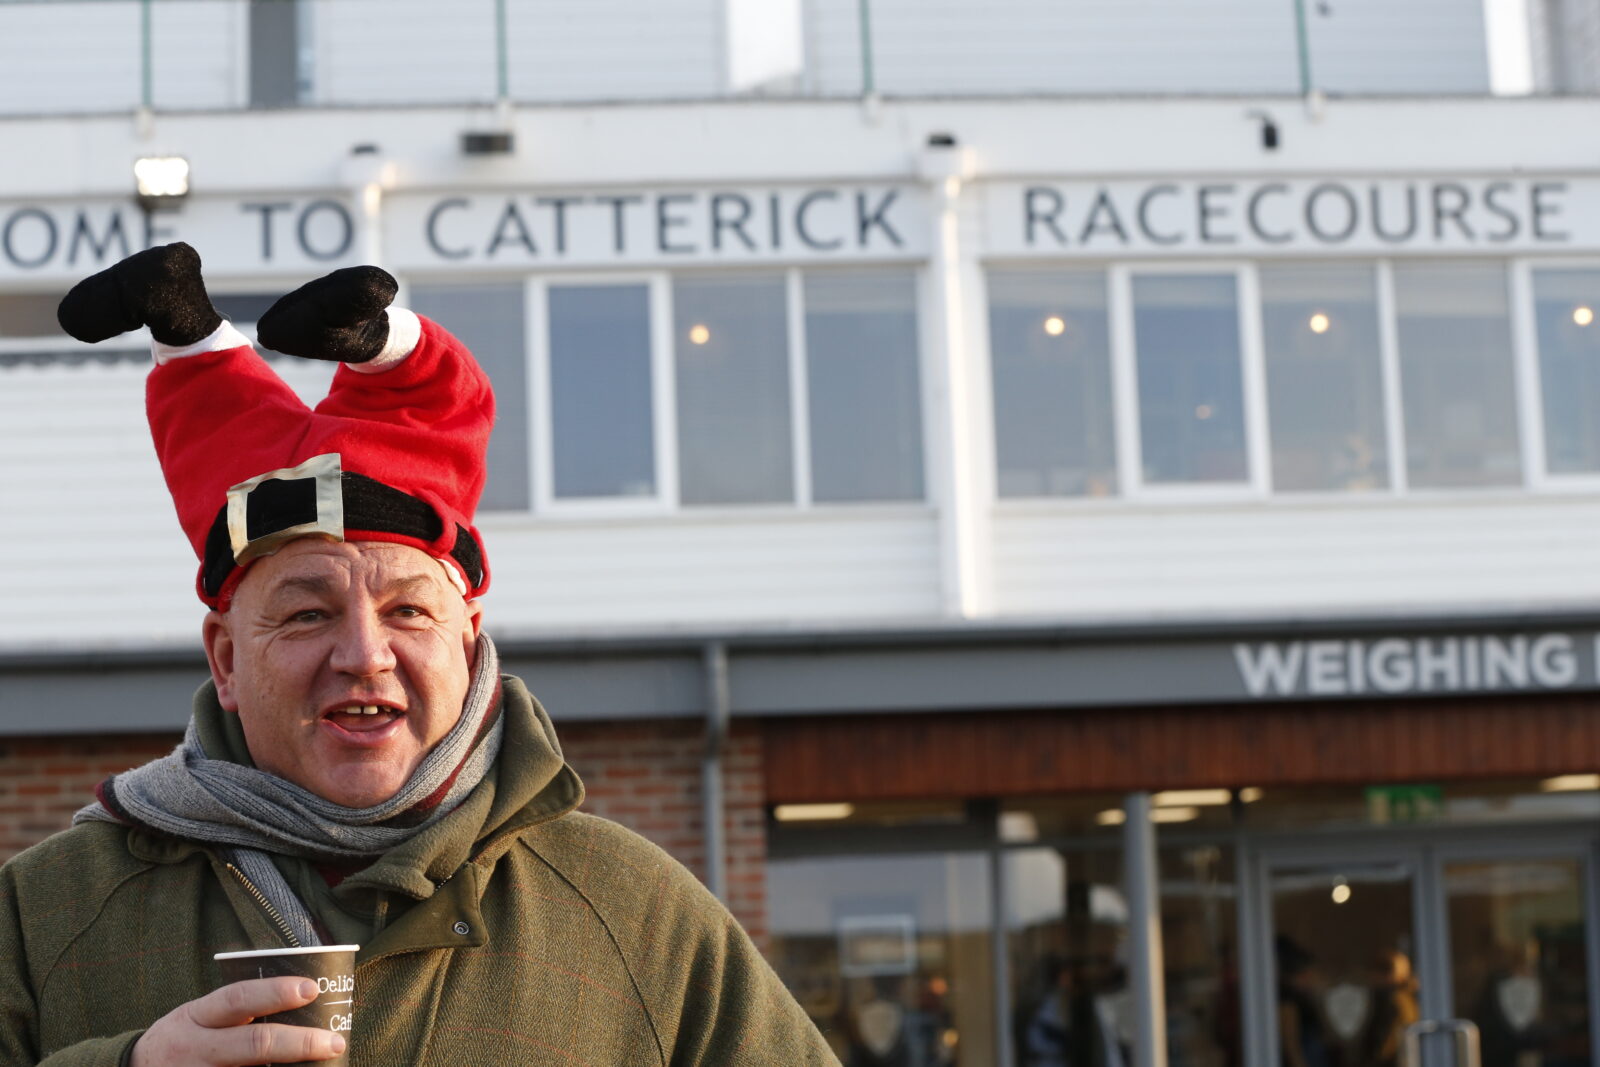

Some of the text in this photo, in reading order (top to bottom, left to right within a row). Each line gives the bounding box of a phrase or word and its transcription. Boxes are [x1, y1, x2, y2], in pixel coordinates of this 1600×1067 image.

[240, 199, 354, 261] TO
[426, 188, 903, 260] CATTERICK
[1023, 182, 1570, 246] RACECOURSE
[1235, 633, 1577, 697] WEIGHING
